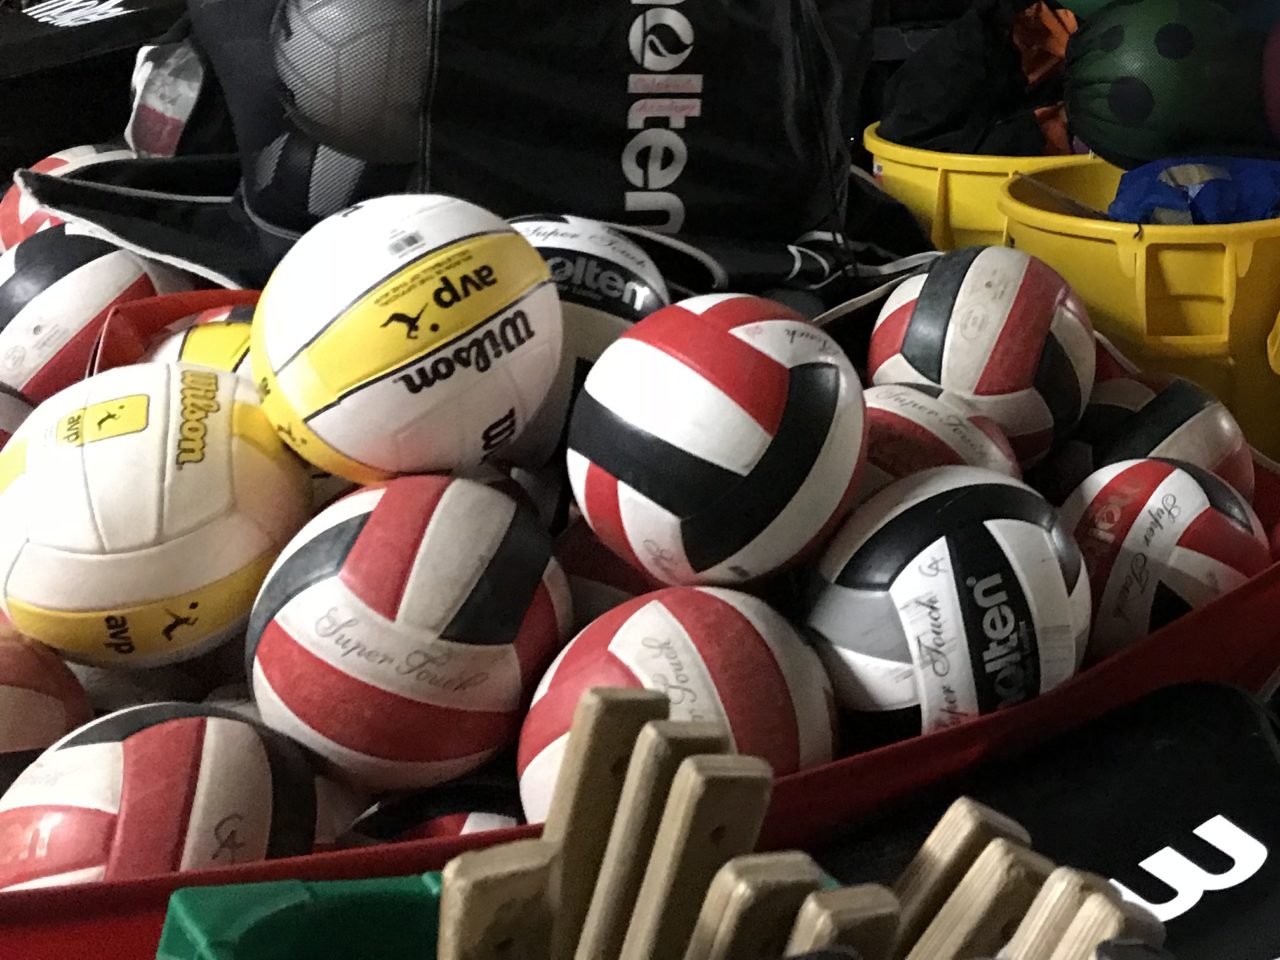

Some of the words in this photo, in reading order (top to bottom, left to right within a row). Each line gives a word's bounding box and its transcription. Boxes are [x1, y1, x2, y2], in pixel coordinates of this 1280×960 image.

[432, 263, 498, 309] avp
[547, 255, 650, 312] olten
[399, 309, 536, 394] Wilson
[63, 410, 82, 444] avp
[175, 369, 220, 465] Wilson
[875, 390, 939, 417] Super
[1143, 493, 1182, 548] Super
[103, 615, 136, 654] avp
[314, 606, 394, 666] Super
[914, 594, 950, 677] Touch
[973, 573, 1027, 701] olten
